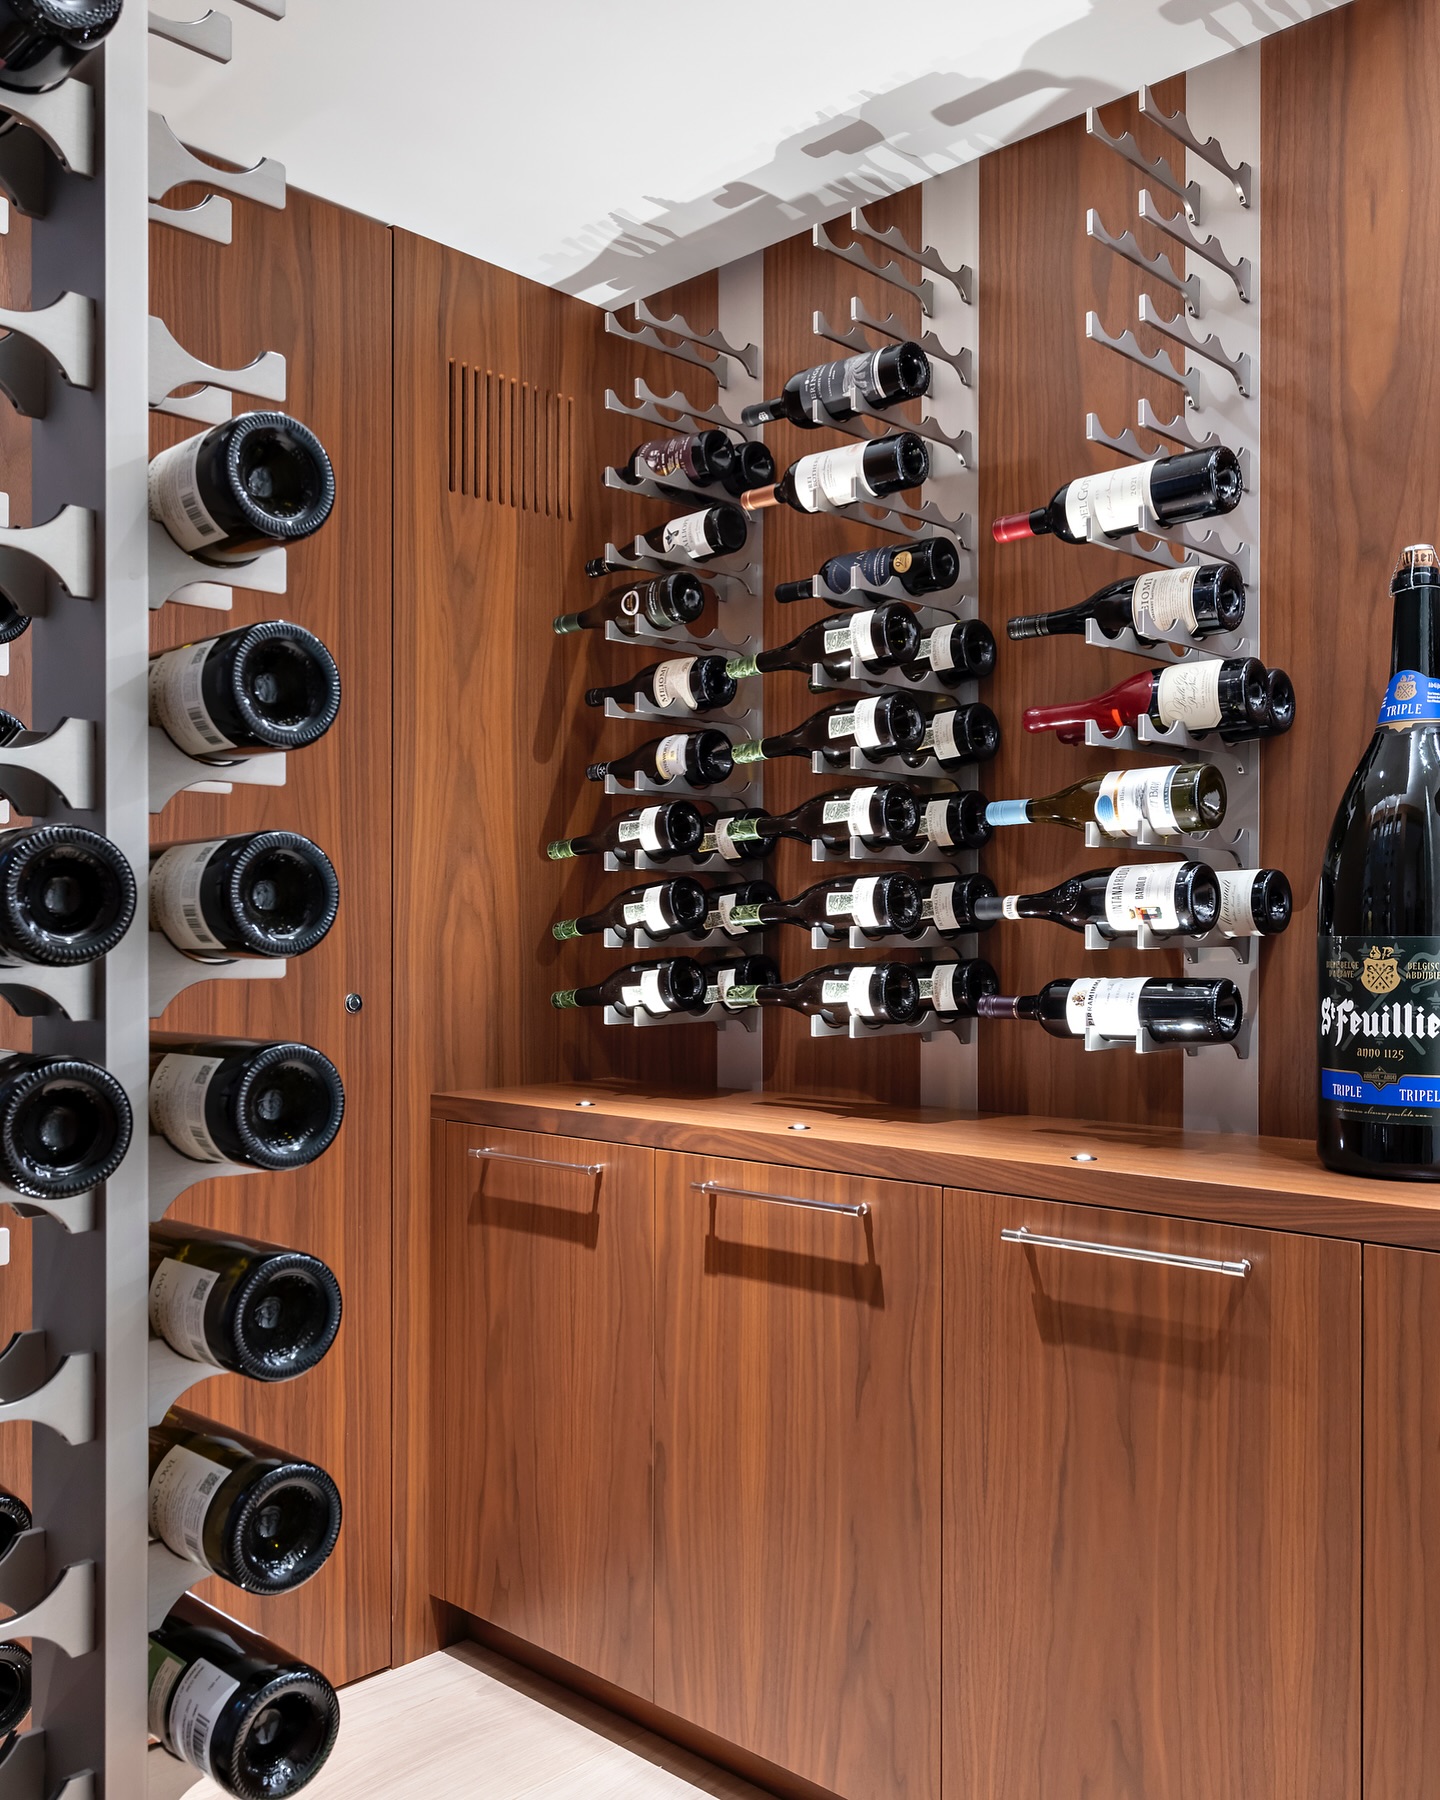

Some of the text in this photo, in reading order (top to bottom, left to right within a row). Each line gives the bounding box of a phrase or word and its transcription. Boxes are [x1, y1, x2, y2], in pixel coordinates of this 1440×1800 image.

[1386, 703, 1422, 717] TRIPLE
[1134, 876, 1147, 900] BAROLO
[1356, 1047, 1404, 1062] anno 1125
[1332, 1083, 1362, 1098] TRIPLE
[1399, 1088, 1440, 1103] TRIPEL
[158, 1458, 177, 1485] OWL
